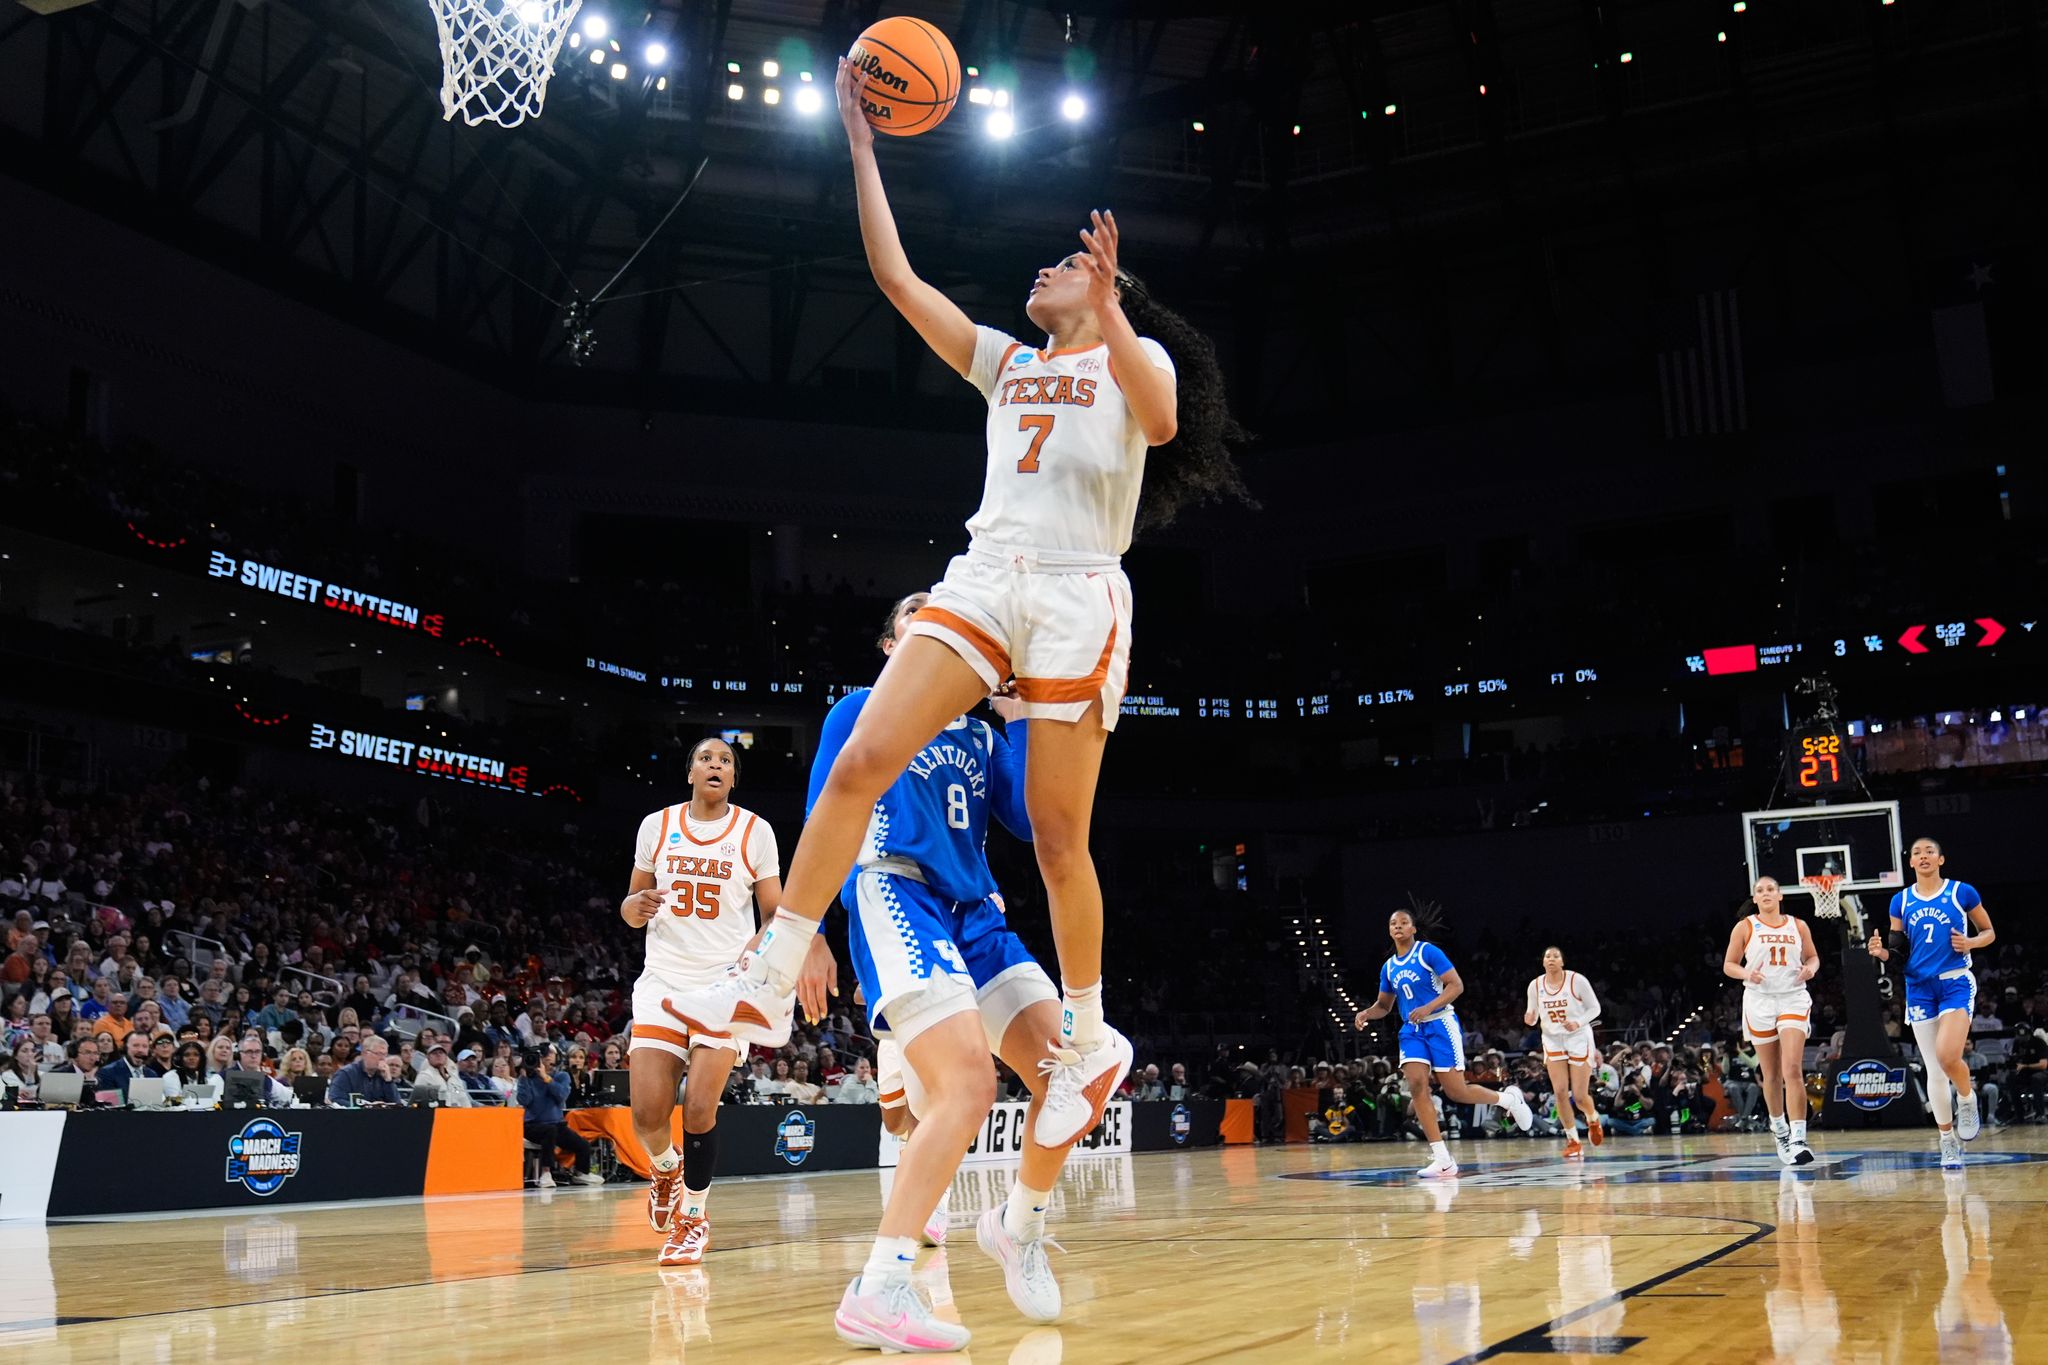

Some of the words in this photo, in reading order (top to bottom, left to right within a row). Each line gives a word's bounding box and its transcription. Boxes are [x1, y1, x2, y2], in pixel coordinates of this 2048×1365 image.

[861, 96, 892, 120] AA
[999, 375, 1097, 408] TEXAS
[1017, 414, 1055, 473] 7
[240, 560, 322, 603] SWEET
[324, 584, 419, 630] SIXTEEN
[1935, 622, 1966, 639] 5:22
[1759, 645, 1794, 655] TIMEOUTS
[1834, 639, 1846, 656] 3
[1944, 637, 1960, 647] 1ST
[1760, 656, 1781, 665] FOULS
[1785, 655, 1790, 663] 2
[586, 657, 595, 668] 13
[661, 677, 668, 687] 0
[673, 678, 693, 689] PTS
[783, 683, 803, 693] AST
[1358, 695, 1372, 706] FG
[1444, 683, 1469, 697] 3-PT
[1478, 679, 1507, 693] 50%
[1551, 673, 1564, 685] FT
[1576, 669, 1597, 682] 0%
[1199, 698, 1206, 707] 0
[1212, 698, 1230, 708] PTS
[1311, 695, 1329, 705] AST
[1140, 706, 1180, 716] MORGAN
[1199, 708, 1206, 717] 0
[1212, 708, 1230, 718] PTS
[1246, 709, 1253, 719] 0
[1299, 707, 1305, 717] 1
[1312, 705, 1329, 715] AST
[1802, 735, 1840, 756] 5:22
[339, 730, 415, 766] SWEET
[416, 746, 504, 783] SIXTEEN
[908, 745, 985, 800] KENTUCKY
[1800, 754, 1839, 787] 27
[947, 783, 969, 830] 8
[667, 855, 733, 880] TEXAS
[670, 880, 721, 920] 35
[1910, 907, 1950, 926] KENTUCKY
[1759, 934, 1796, 945] TEXAS
[1923, 923, 1935, 943] 7
[1769, 946, 1787, 967] 11
[1402, 983, 1414, 1000] 0
[1543, 999, 1567, 1009] TEXAS
[1548, 1009, 1567, 1023] 25
[1850, 1072, 1886, 1085] MARCH
[1854, 1082, 1904, 1095] MADNESS
[986, 1108, 1007, 1154] 12
[243, 1138, 282, 1155] MARCH
[248, 1153, 298, 1171] MADNESS
